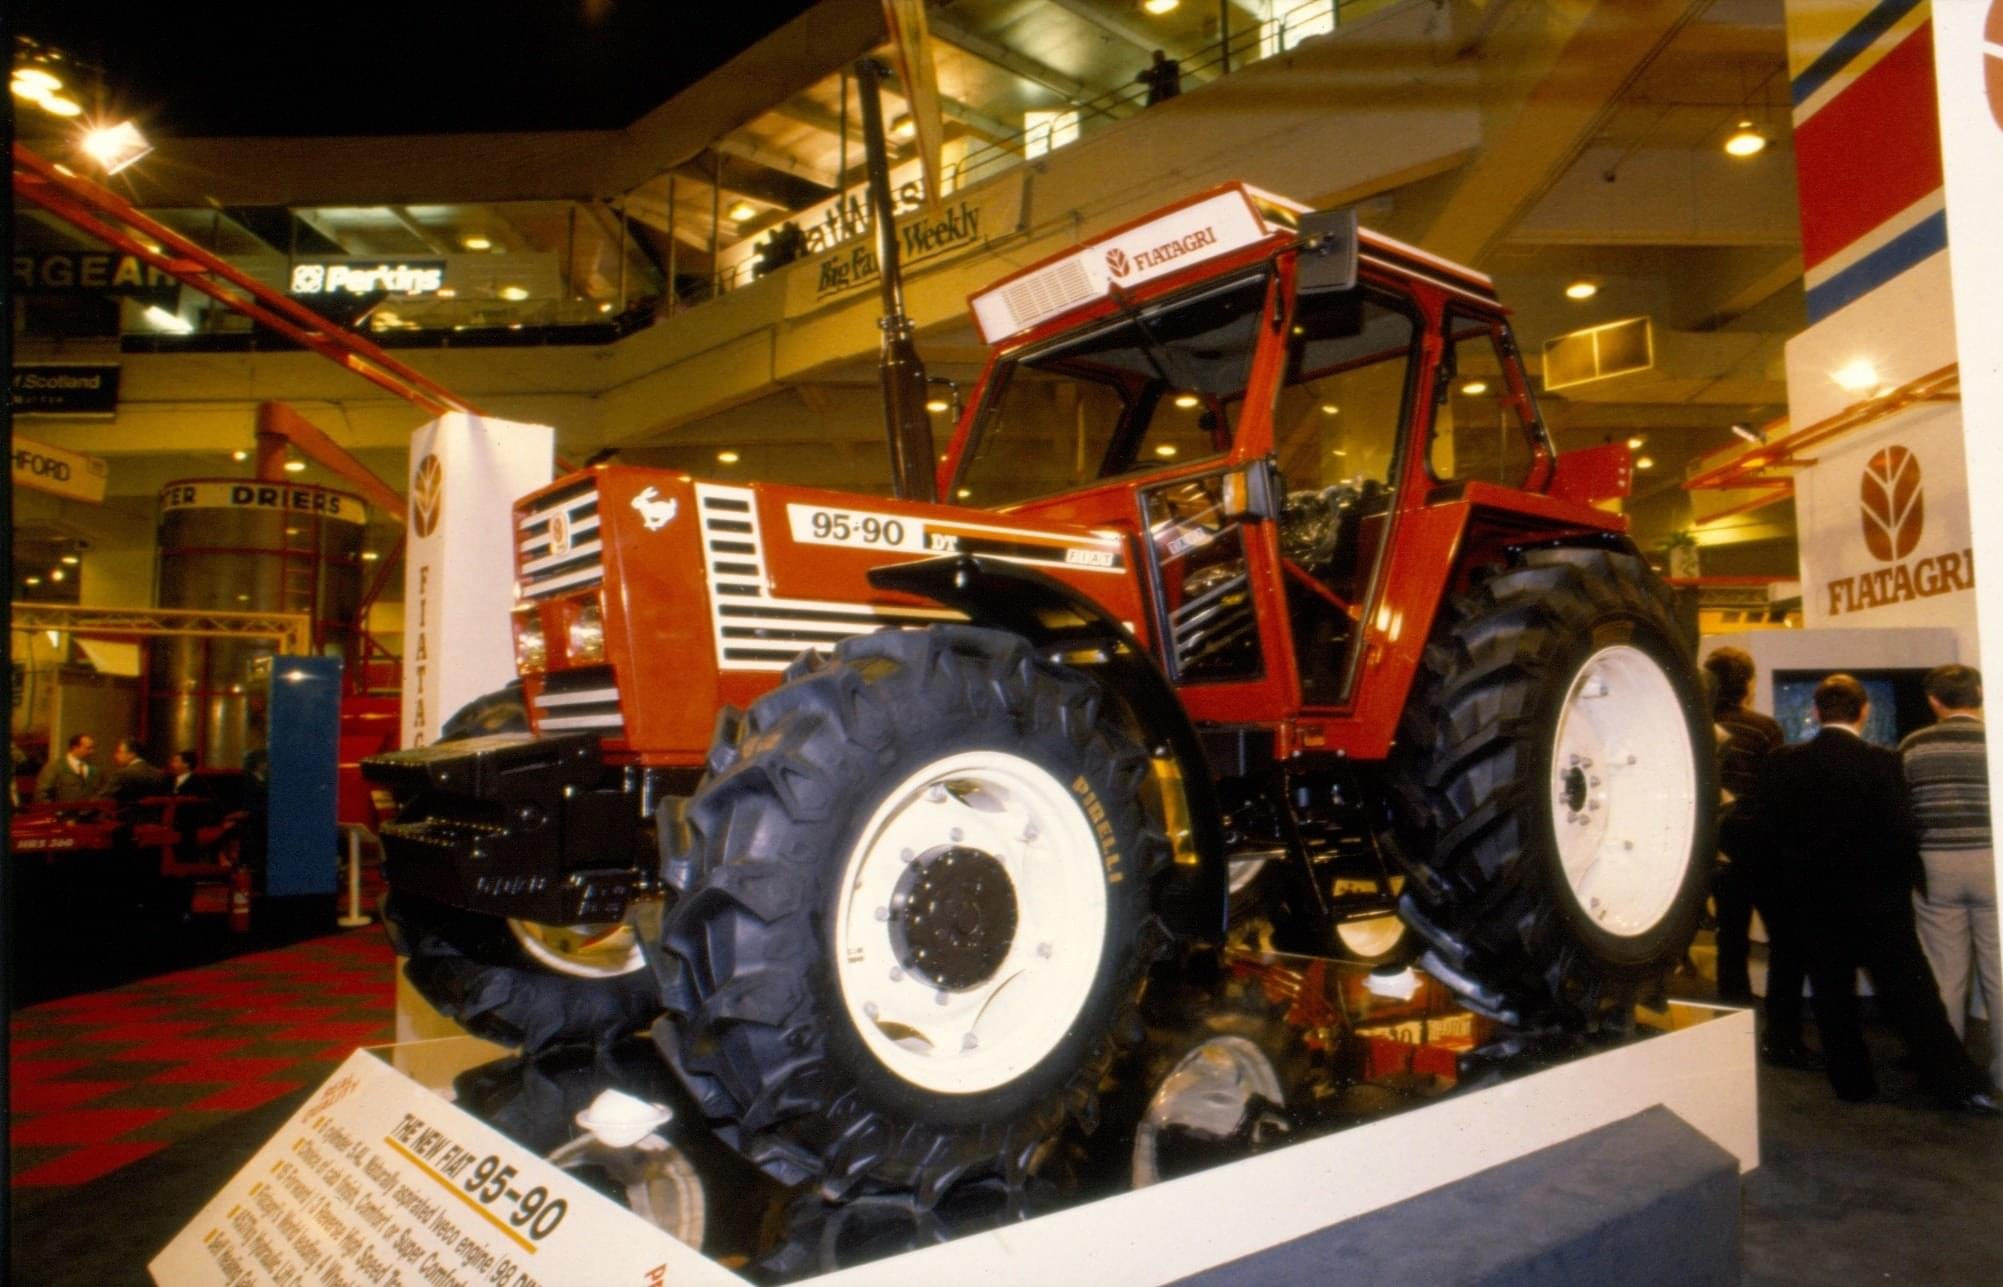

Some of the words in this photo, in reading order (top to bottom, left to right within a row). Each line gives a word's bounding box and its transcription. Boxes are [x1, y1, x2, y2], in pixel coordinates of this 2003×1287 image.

[325, 264, 442, 292] Perkins
[817, 254, 850, 292] Big
[903, 201, 980, 257] Weekly
[1133, 226, 1217, 271] FIATAGRI
[22, 373, 102, 390] Scotland
[231, 486, 341, 515] DRIERS
[1067, 549, 1113, 567] FIAT
[1827, 547, 1975, 616] FIATAGRI
[1071, 775, 1123, 883] PIRELLI
[393, 1112, 425, 1144] THE
[409, 1123, 450, 1167] NEW
[436, 1141, 476, 1179] FIAT
[463, 1154, 569, 1242] 95-90
[314, 1201, 347, 1241] Reverse
[337, 1226, 365, 1259] High
[355, 1243, 393, 1284] Speed
[354, 1191, 393, 1232] Comfort
[382, 1223, 400, 1239] or
[392, 1227, 426, 1263] Super
[363, 1154, 401, 1196] Naturally
[392, 1182, 441, 1224] aspirated
[428, 1208, 461, 1245] Iveco
[455, 1236, 494, 1274] engine
